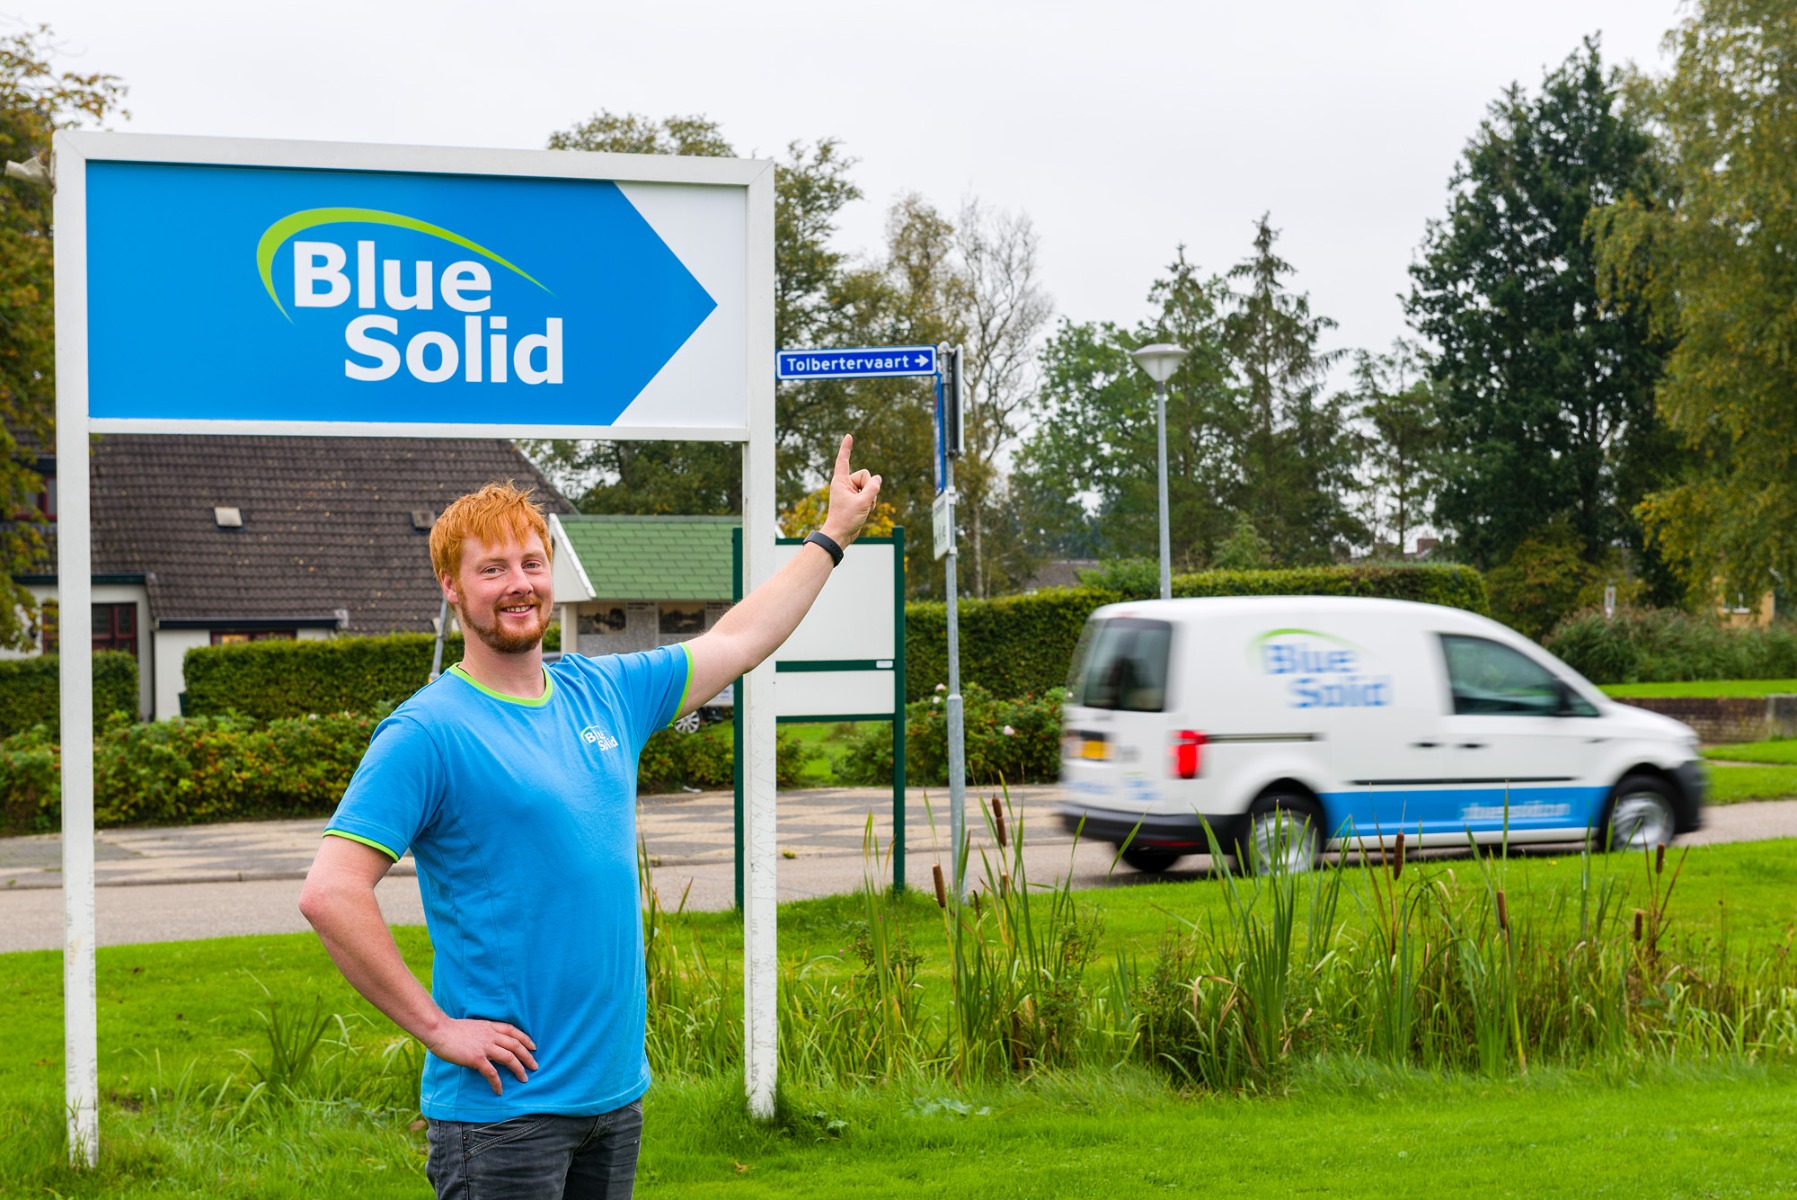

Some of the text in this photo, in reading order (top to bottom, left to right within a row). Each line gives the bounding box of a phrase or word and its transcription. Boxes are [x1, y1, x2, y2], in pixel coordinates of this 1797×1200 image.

[294, 240, 492, 313] Blue
[345, 314, 564, 385] Solid
[786, 355, 910, 372] Tolbertervaart
[1261, 643, 1360, 675] Blue
[1286, 675, 1394, 709] Solid
[584, 729, 607, 744] Blu
[597, 735, 619, 751] Slid
